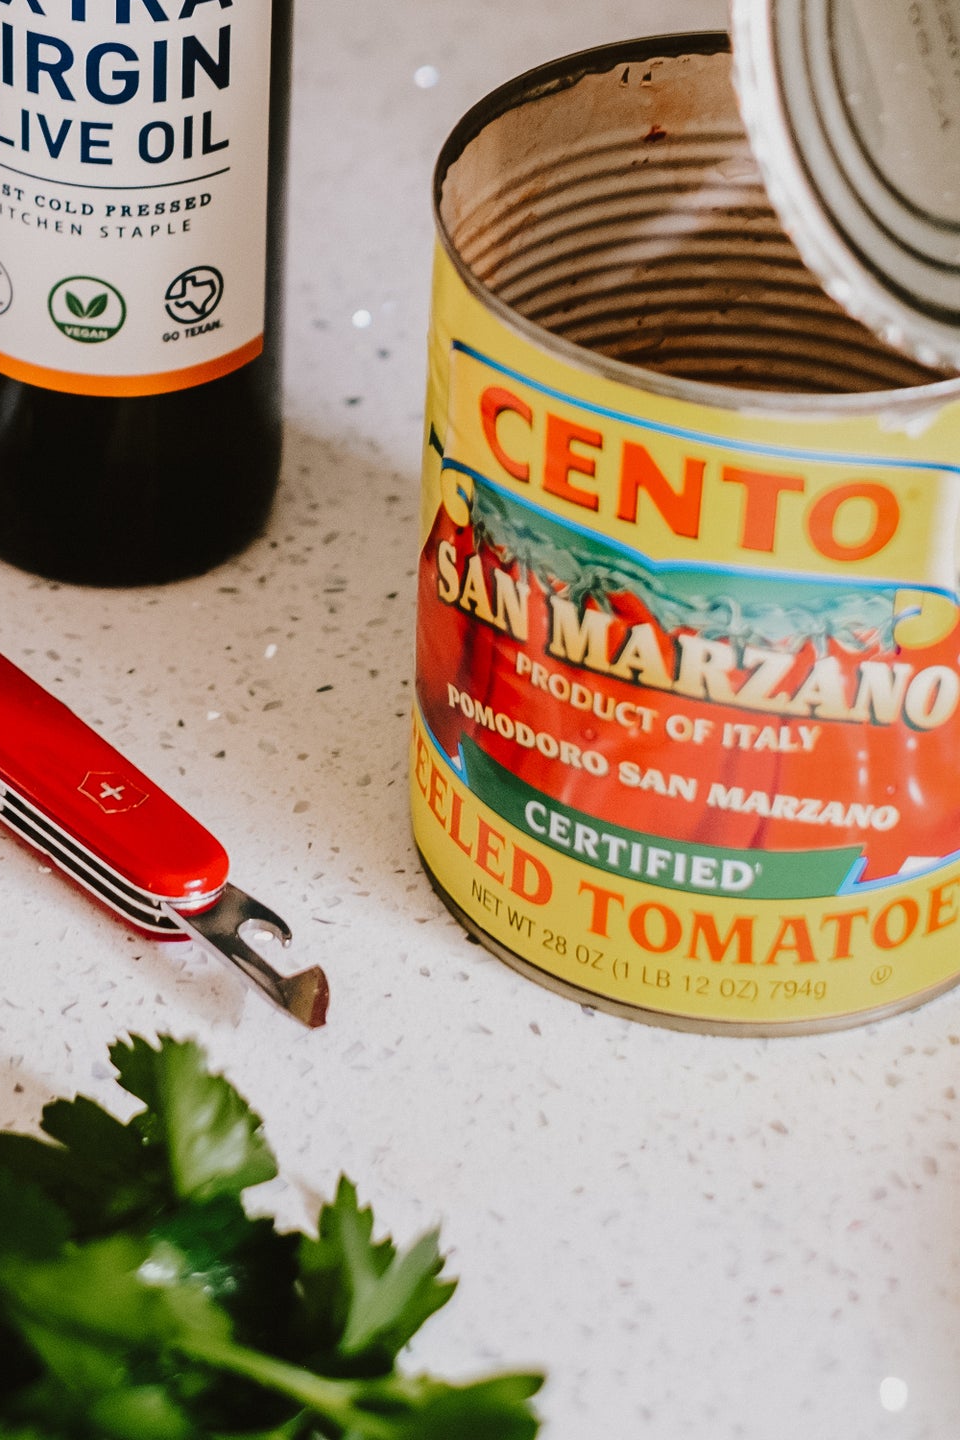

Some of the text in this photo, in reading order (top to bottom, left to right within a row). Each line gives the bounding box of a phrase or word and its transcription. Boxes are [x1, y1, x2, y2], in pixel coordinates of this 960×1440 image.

[138, 110, 230, 164] OIL
[34, 195, 94, 216] COLD
[105, 192, 212, 217] PRESSED
[100, 218, 191, 238] STAPLE
[64, 326, 108, 339] VEGAN
[162, 331, 180, 343] GO
[480, 385, 900, 563] CENTO
[436, 539, 959, 733] SAN MARZANO
[515, 651, 822, 753] PRODUCT OF ITALY
[447, 681, 901, 832] POMODORO SAN MARZANO
[413, 710, 553, 907] EELED
[471, 878, 828, 1003] NET WT 28 OZ (1 LB 12 OZ) 794g
